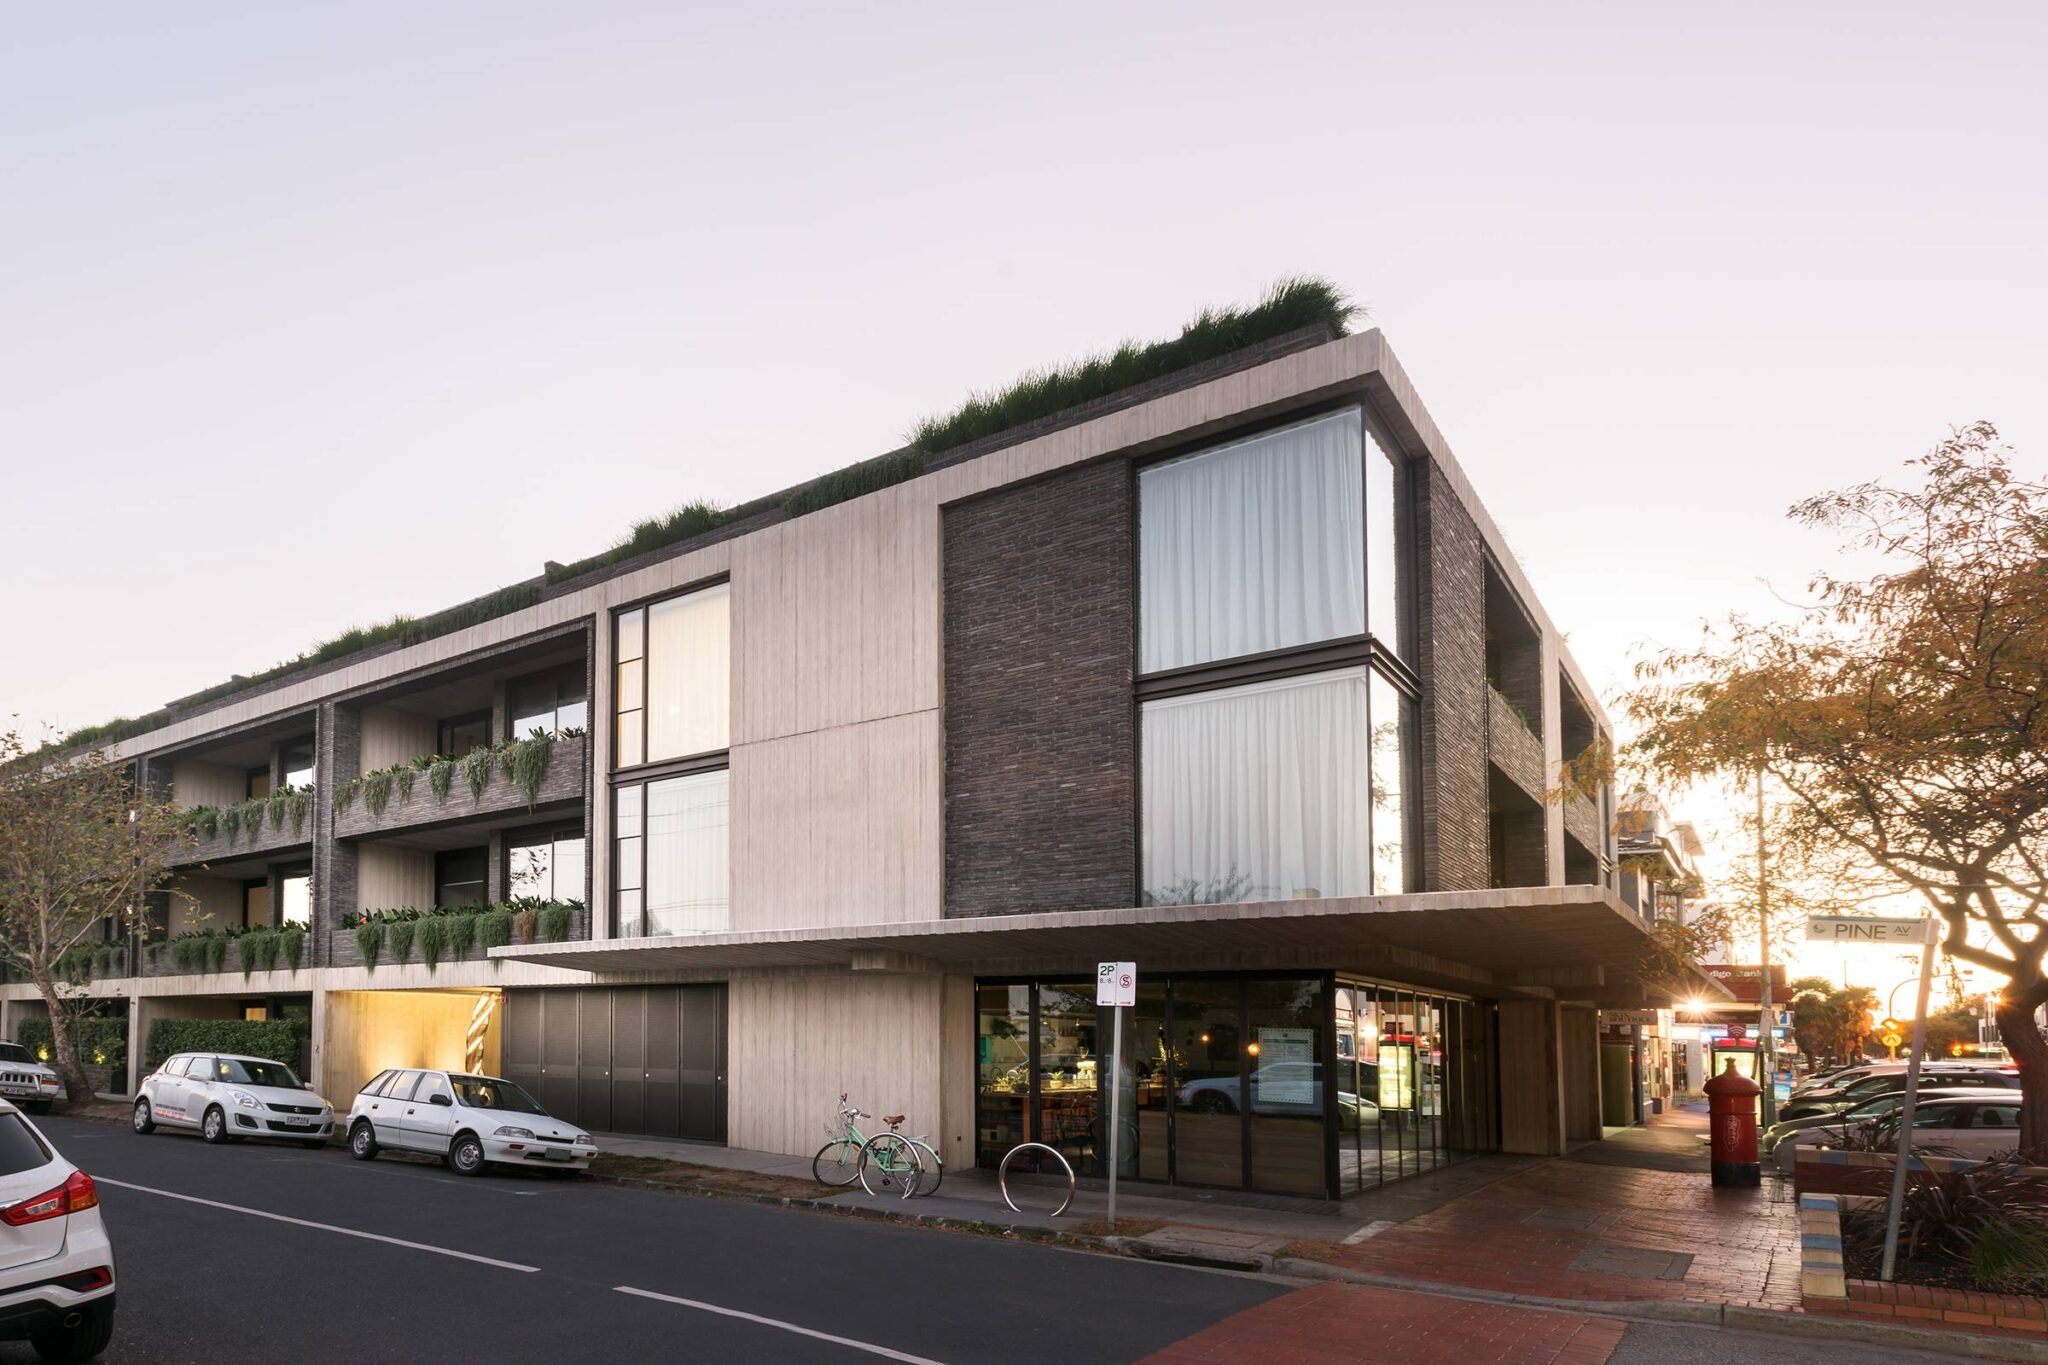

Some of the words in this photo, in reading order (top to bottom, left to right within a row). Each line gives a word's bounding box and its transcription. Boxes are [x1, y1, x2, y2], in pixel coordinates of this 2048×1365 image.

[1835, 924, 1887, 939] PINE
[1893, 926, 1912, 935] AV
[1100, 965, 1115, 976] 2P
[1709, 969, 1732, 979] digo
